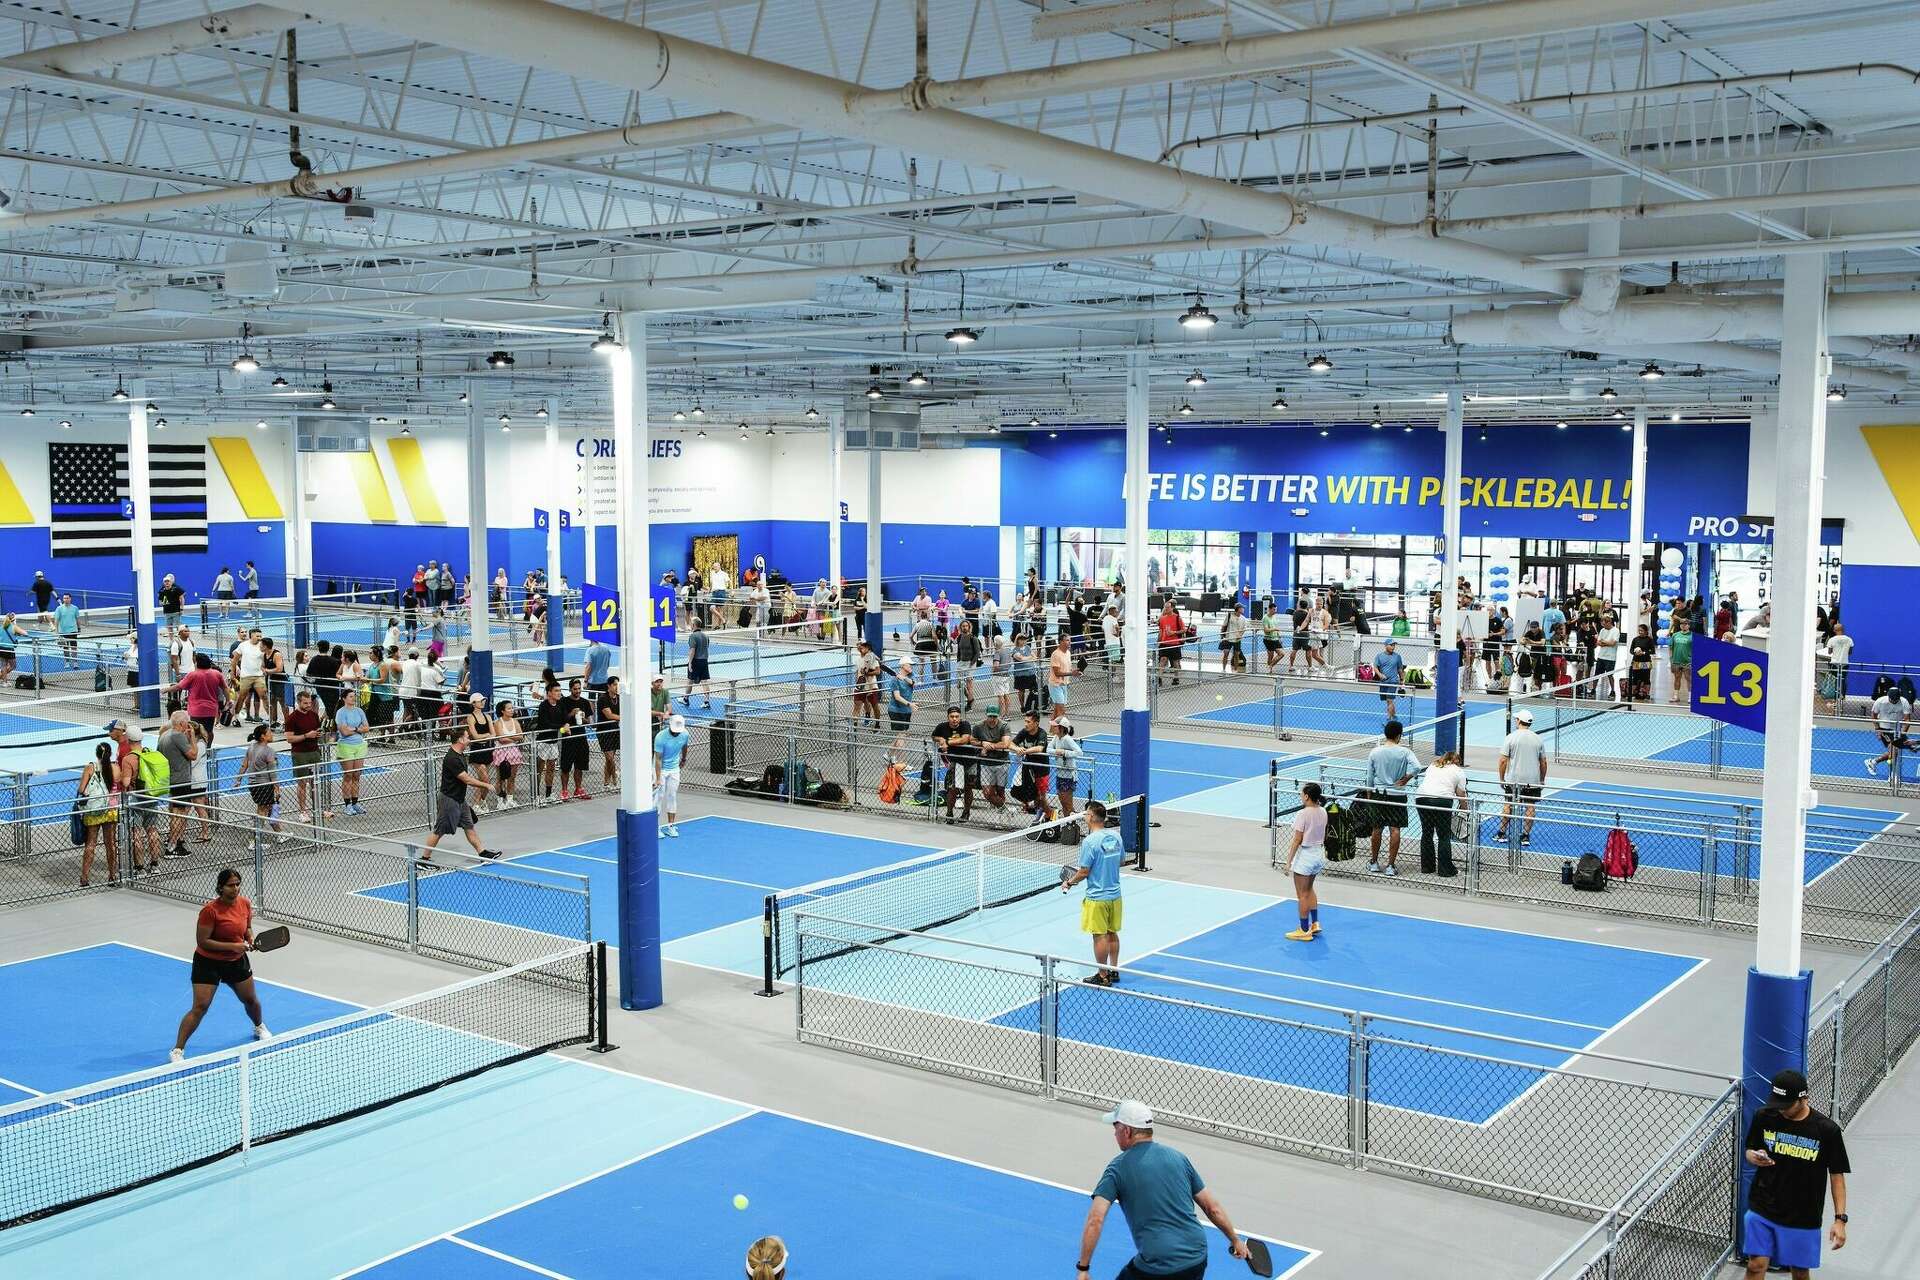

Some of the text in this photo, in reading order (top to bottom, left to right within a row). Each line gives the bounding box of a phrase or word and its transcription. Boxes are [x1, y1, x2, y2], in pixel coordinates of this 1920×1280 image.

[647, 440, 682, 458] IEFS
[1181, 473, 1207, 501] IS
[1211, 474, 1319, 503] BETTER
[1326, 475, 1410, 505] WITH
[126, 504, 133, 514] 2
[538, 514, 545, 527] 6
[561, 515, 567, 527] 5
[1688, 516, 1739, 537] PRO
[1434, 537, 1445, 554] 10
[585, 599, 618, 631] 12
[1697, 661, 1763, 706] 13
[1774, 1141, 1819, 1162] KINGDOM
